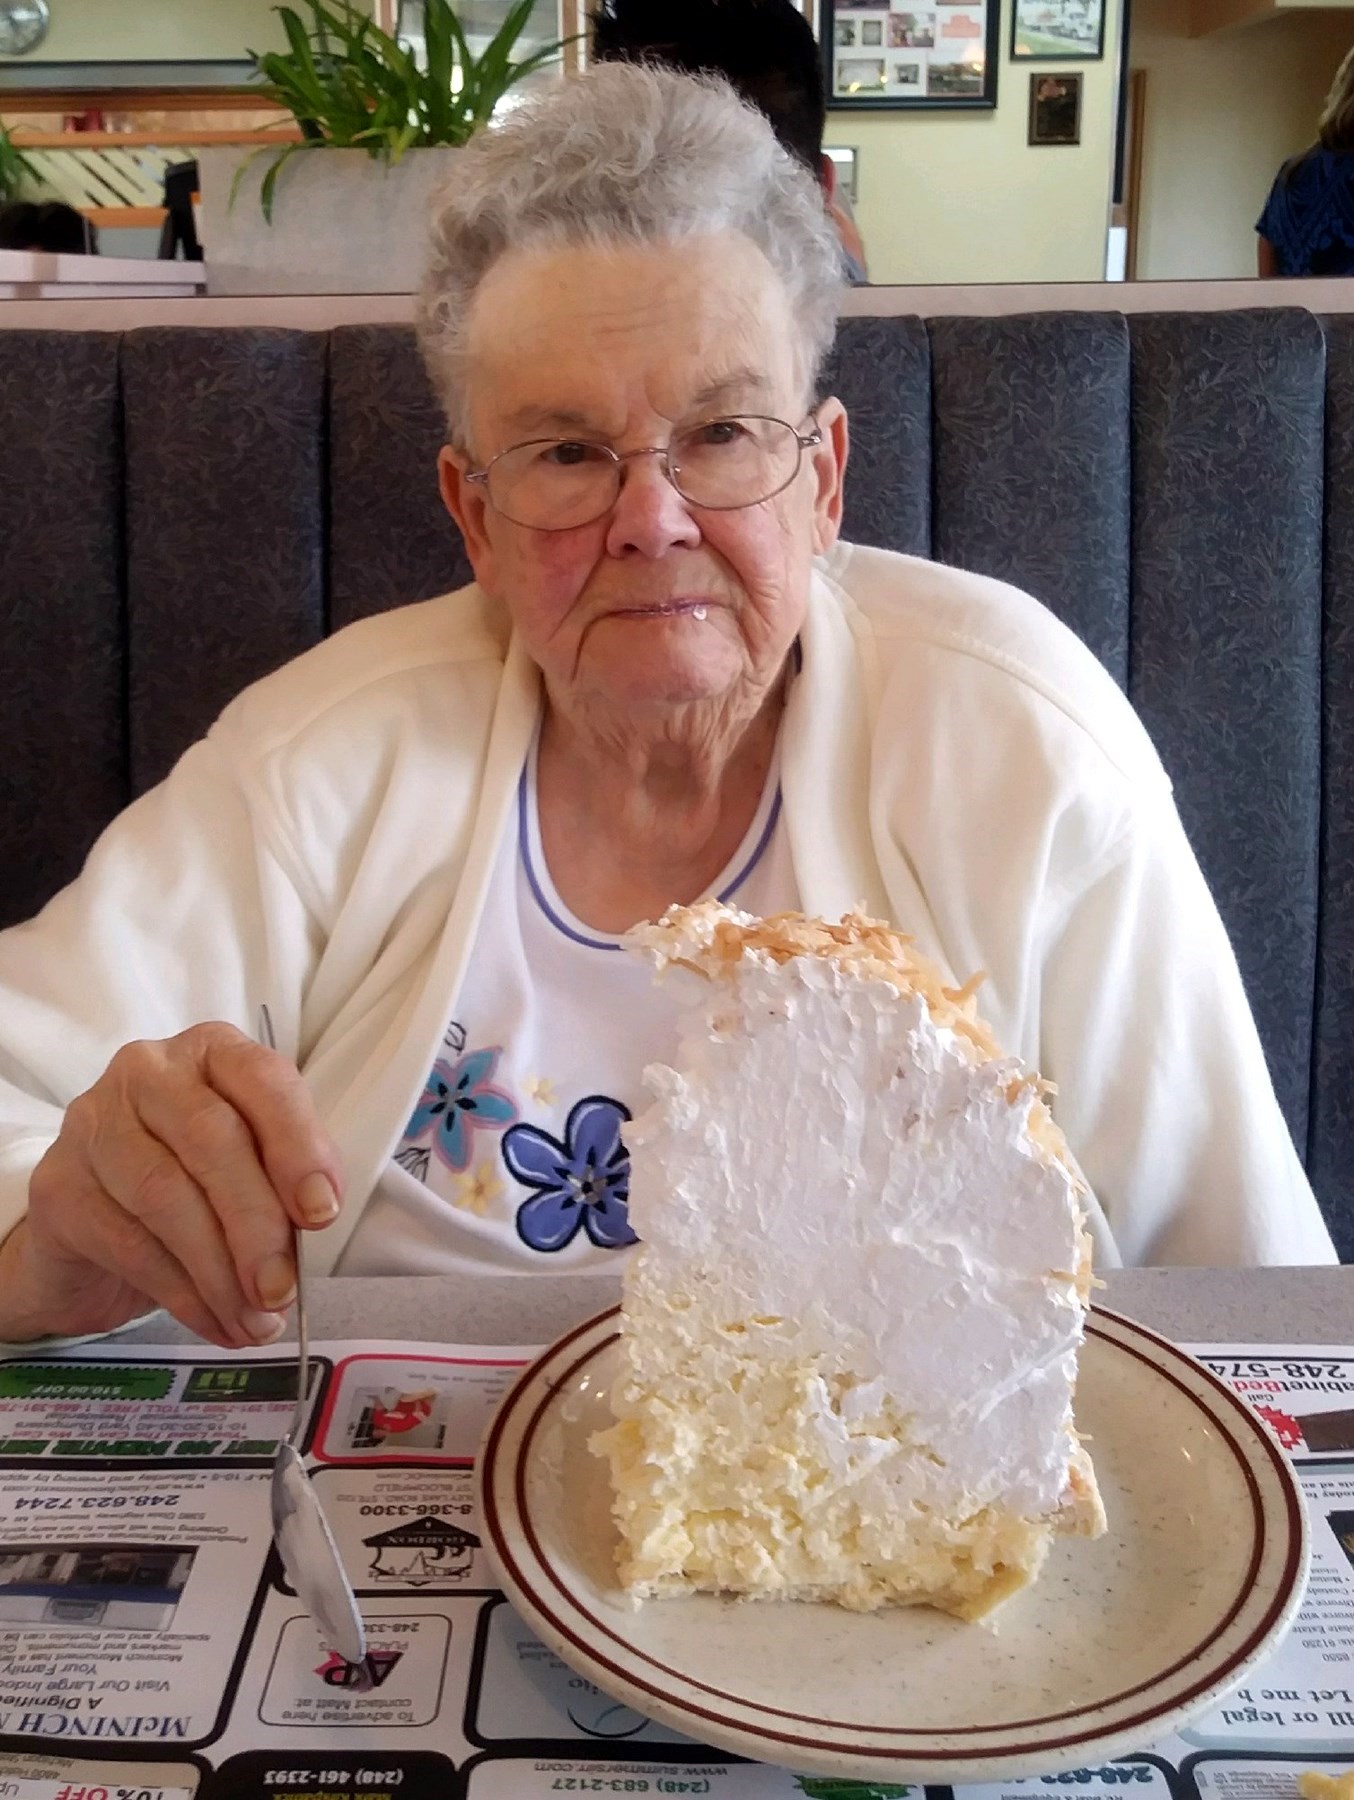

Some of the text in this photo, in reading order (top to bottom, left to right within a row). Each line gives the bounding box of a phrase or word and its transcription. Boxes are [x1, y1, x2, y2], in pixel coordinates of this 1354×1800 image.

[1208, 1363, 1347, 1378] 248-574
[1227, 1380, 1354, 1393] abinetBed
[1247, 1393, 1274, 1402] Call
[15, 1495, 180, 1510] 248.623.7244
[360, 1504, 473, 1516] 8-366-3300
[1, 1663, 97, 1675] Your Family
[47, 1678, 94, 1692] Large
[99, 1680, 130, 1692] Our
[136, 1680, 170, 1692] Visit
[1261, 1690, 1301, 1701] me
[1307, 1690, 1353, 1704] Let
[88, 1697, 104, 1710] A
[296, 1699, 313, 1708] at
[355, 1699, 412, 1709] contact
[282, 1711, 416, 1722] To advertise here
[1221, 1707, 1286, 1726] legal
[1292, 1712, 1319, 1723] or
[17, 1713, 191, 1738] McININCH
[262, 1768, 404, 1785] (248) 461-2393
[551, 1777, 710, 1794] (248) 683-2127
